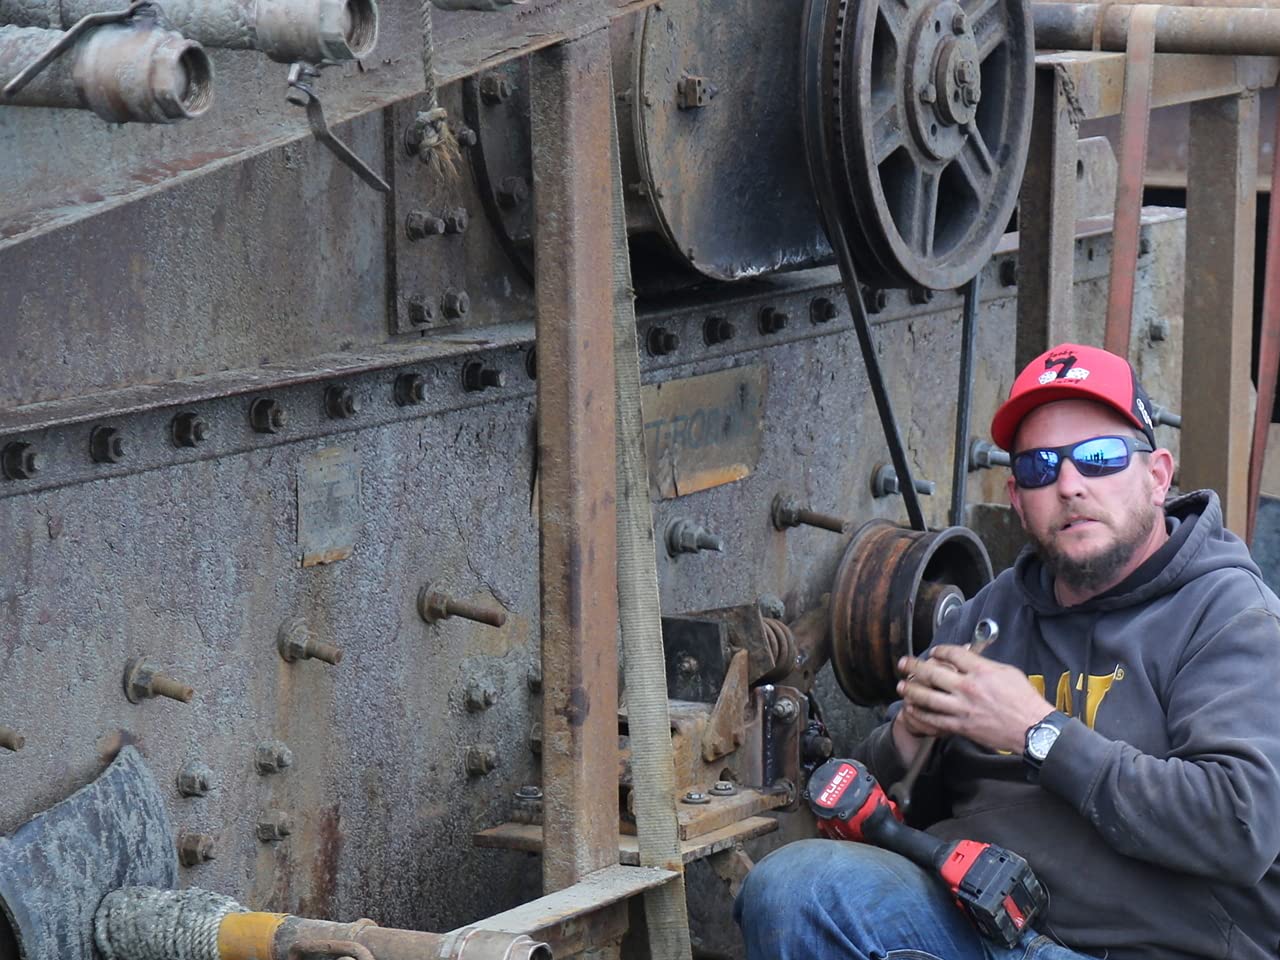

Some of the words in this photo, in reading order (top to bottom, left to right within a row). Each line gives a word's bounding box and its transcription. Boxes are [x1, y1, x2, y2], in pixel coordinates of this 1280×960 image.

[1045, 355, 1077, 379] 7
[1027, 663, 1120, 732] AT
[820, 768, 850, 803] FUEL
